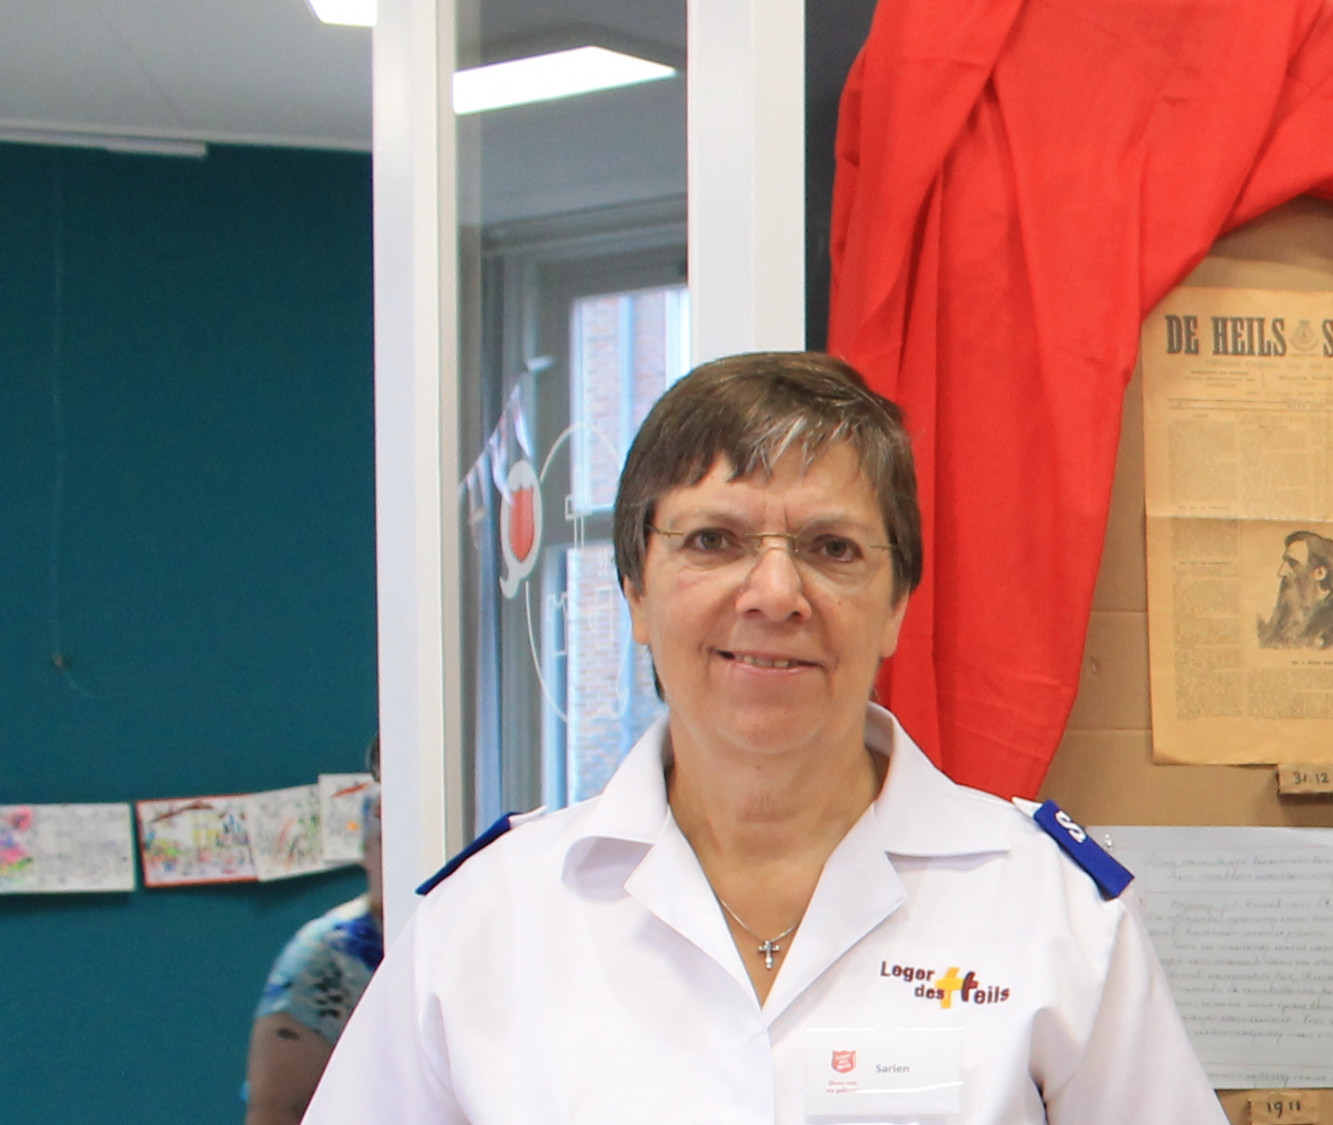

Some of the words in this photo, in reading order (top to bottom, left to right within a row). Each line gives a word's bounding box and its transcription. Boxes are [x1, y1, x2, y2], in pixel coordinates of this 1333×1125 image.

[1165, 315, 1199, 355] DE
[1211, 316, 1287, 357] HEILS
[1055, 811, 1087, 843] S
[880, 961, 935, 982] Leger
[914, 984, 945, 999] des
[875, 1064, 910, 1073] Sarien
[1267, 1101, 1301, 1119] 1911
